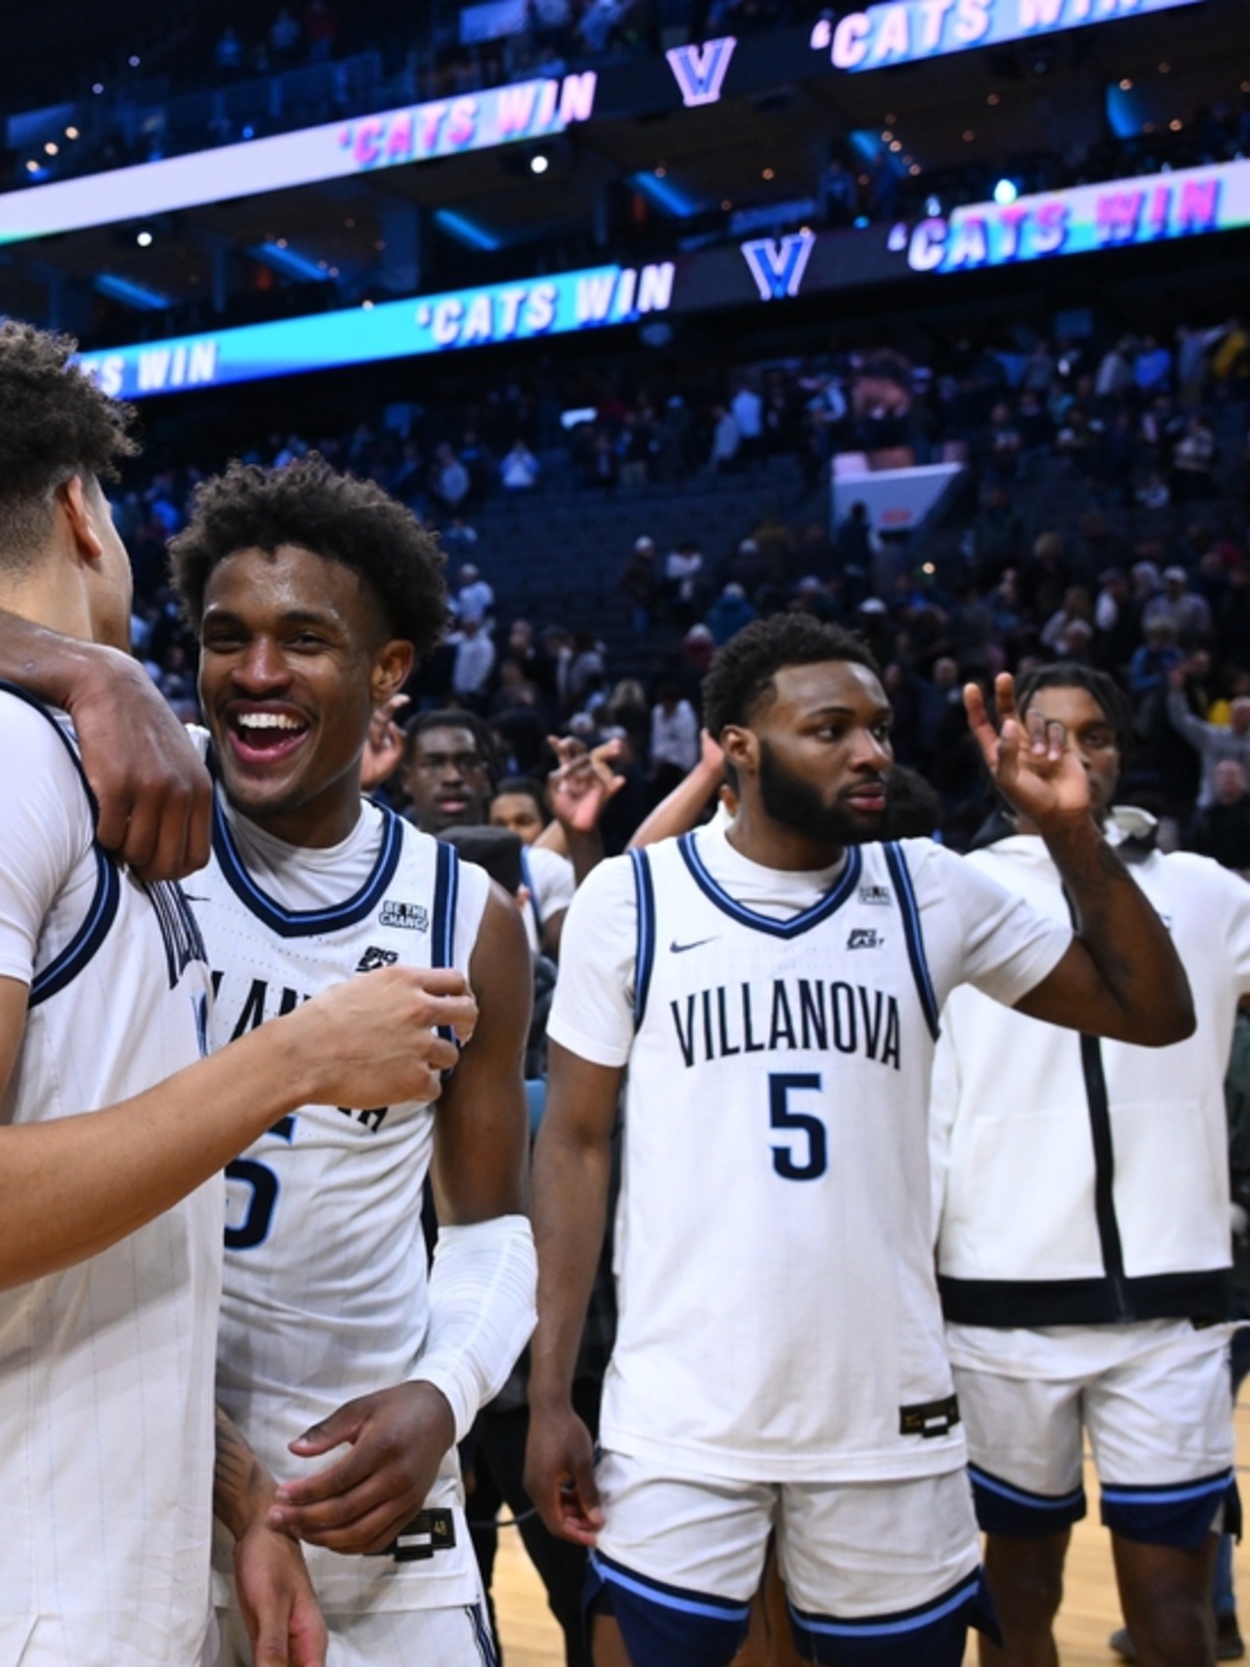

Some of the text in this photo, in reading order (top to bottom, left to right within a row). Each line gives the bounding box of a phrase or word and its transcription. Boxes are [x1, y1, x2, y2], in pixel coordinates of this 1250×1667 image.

[338, 71, 597, 165] 'CATS WIN
[888, 179, 1221, 272] 'CATS WIN
[416, 262, 675, 345] 'CATS WIN
[137, 340, 217, 393] WIN
[669, 978, 901, 1071] VILLANOVA
[767, 1072, 829, 1182] 5
